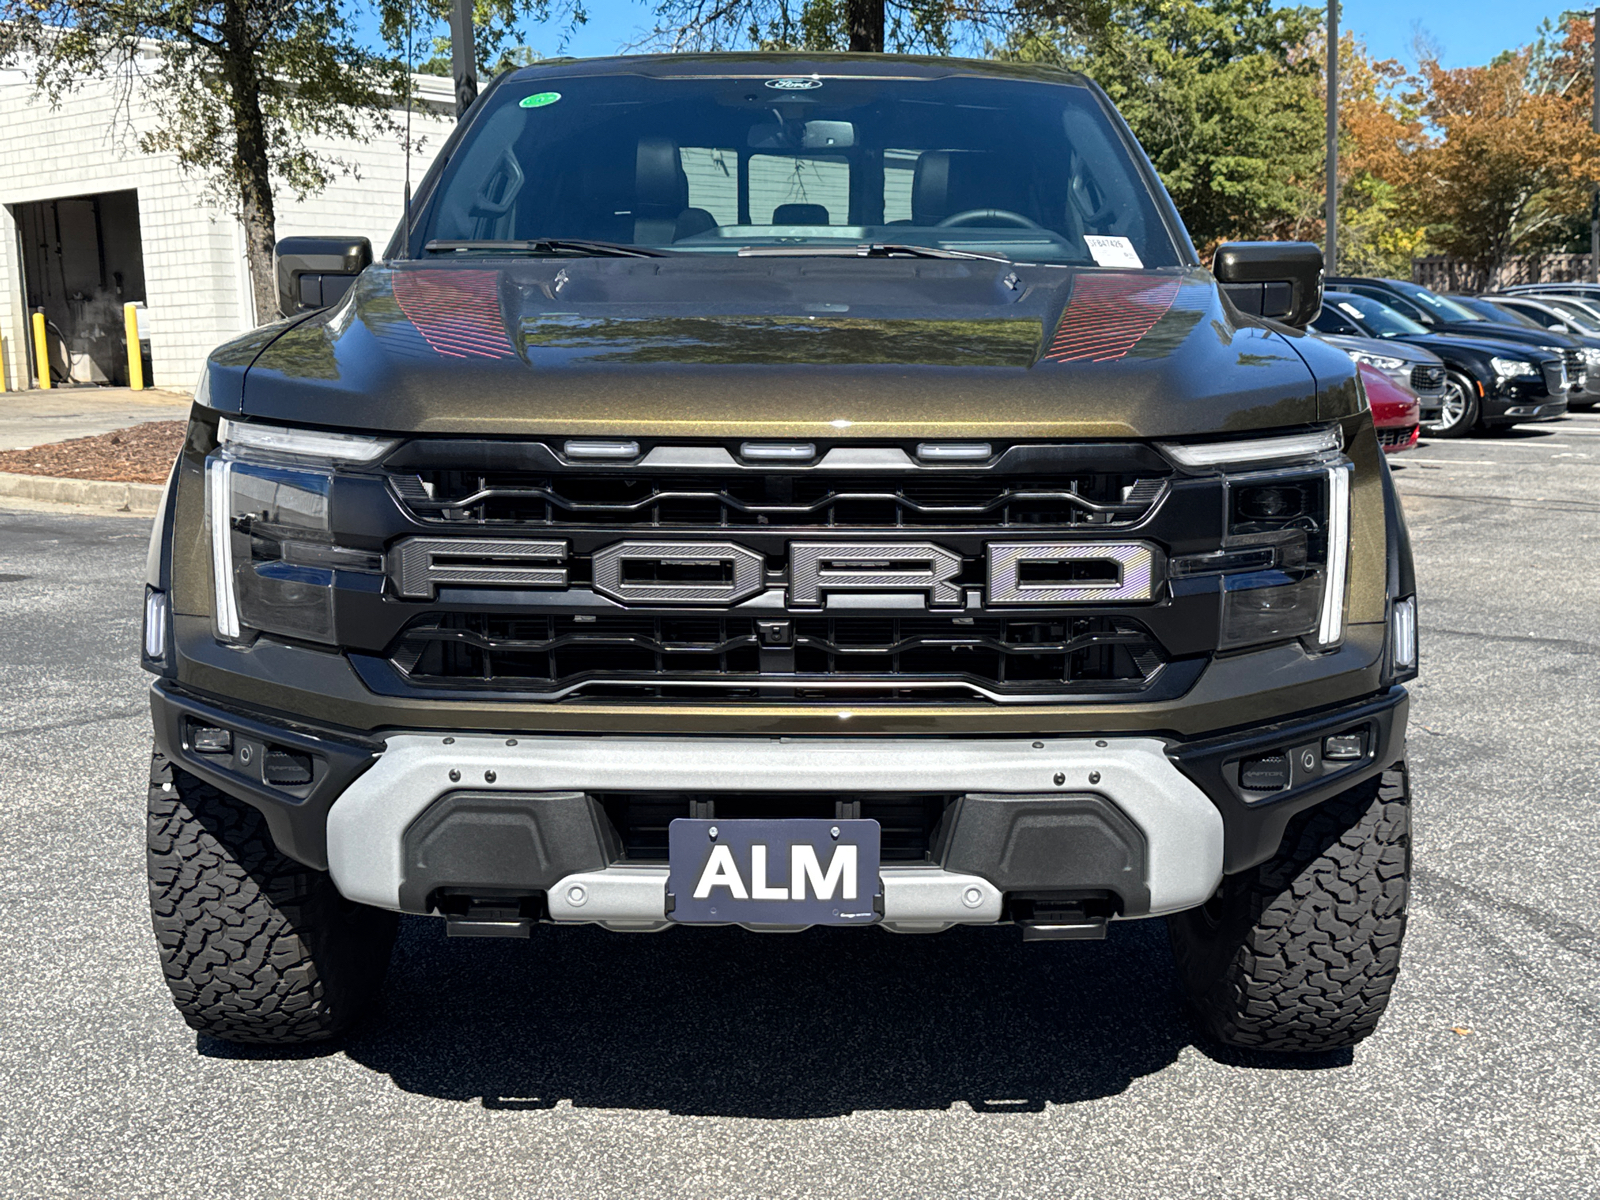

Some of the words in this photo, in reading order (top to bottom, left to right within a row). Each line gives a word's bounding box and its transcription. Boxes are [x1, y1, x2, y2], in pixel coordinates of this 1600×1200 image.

[774, 79, 813, 89] Ford
[394, 536, 1158, 606] FORD
[692, 844, 858, 900] ALM
